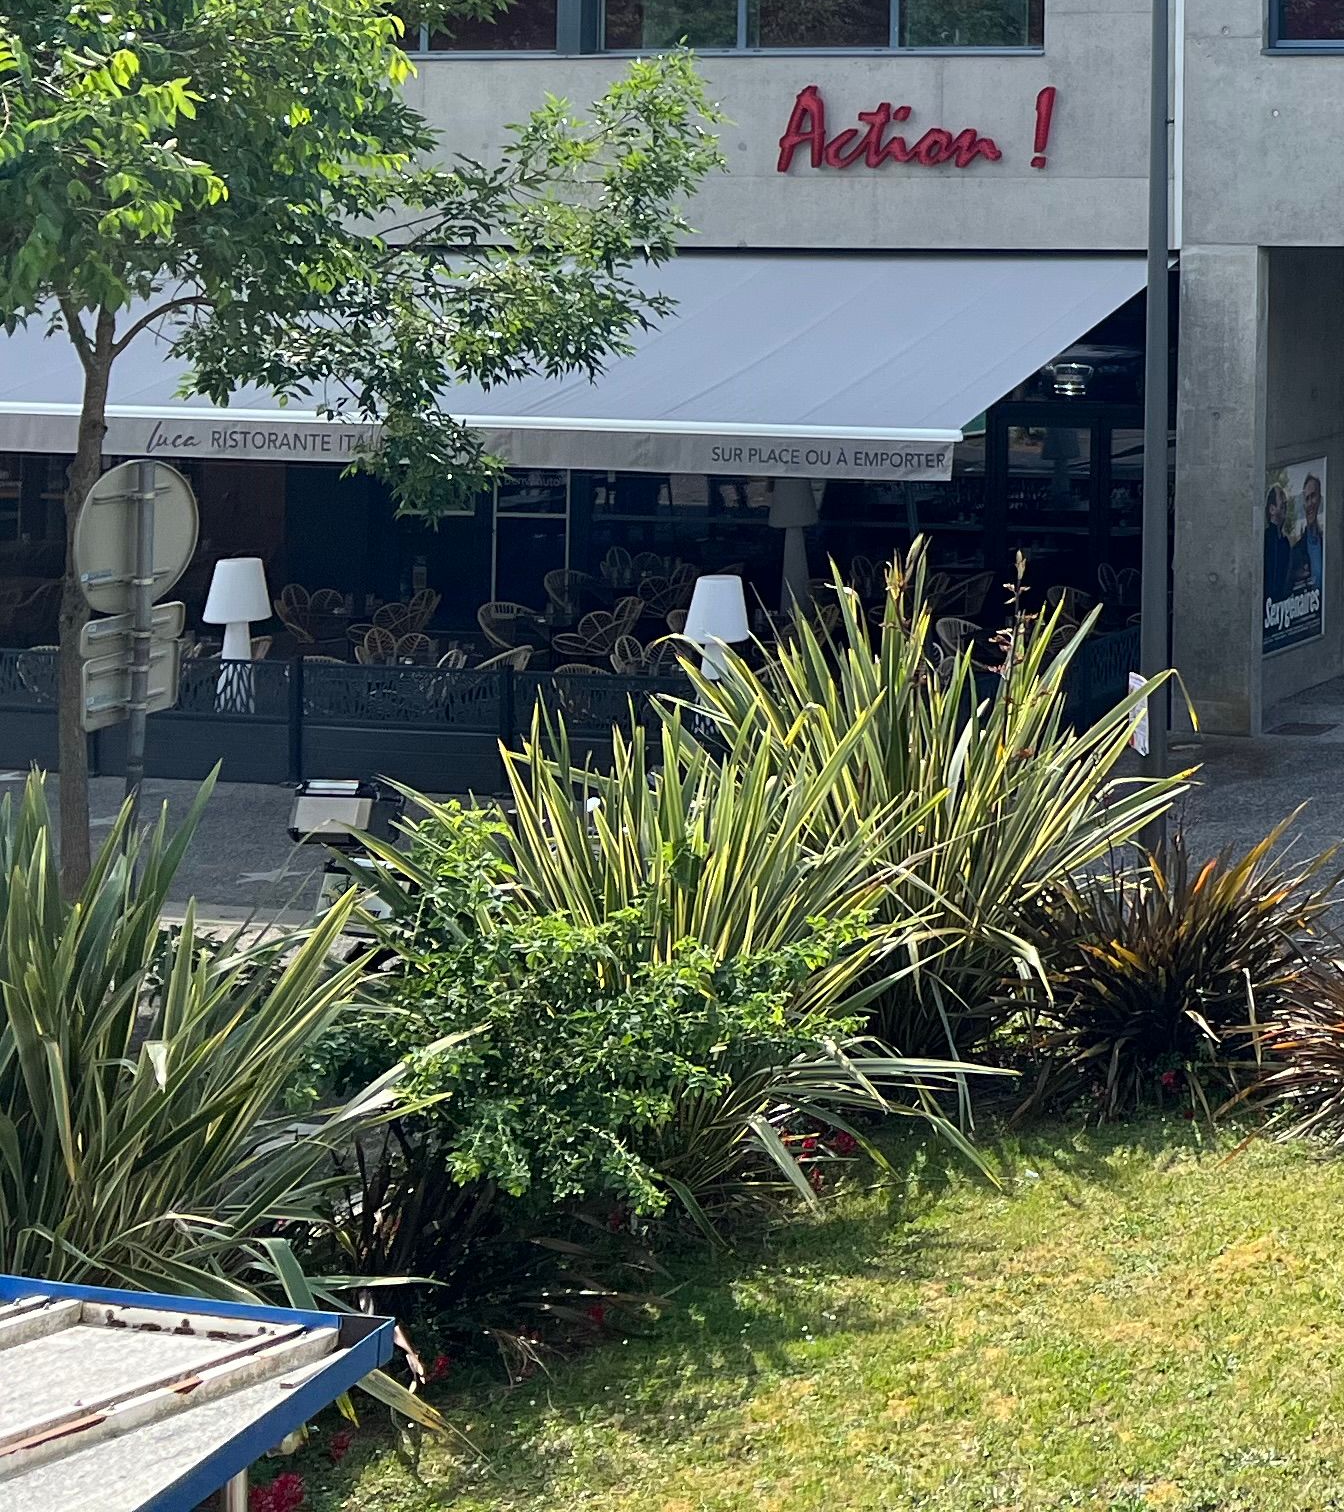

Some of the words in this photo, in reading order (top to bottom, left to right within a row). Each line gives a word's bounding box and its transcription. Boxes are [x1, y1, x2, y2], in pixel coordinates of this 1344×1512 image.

[777, 85, 1003, 173] Action
[1030, 86, 1057, 169] !
[211, 431, 332, 452] RISTORANTE
[711, 446, 743, 463] SUR
[749, 448, 800, 465] PLACE
[805, 449, 831, 466] OU
[836, 447, 849, 467] À
[854, 451, 946, 469] EMPORTER
